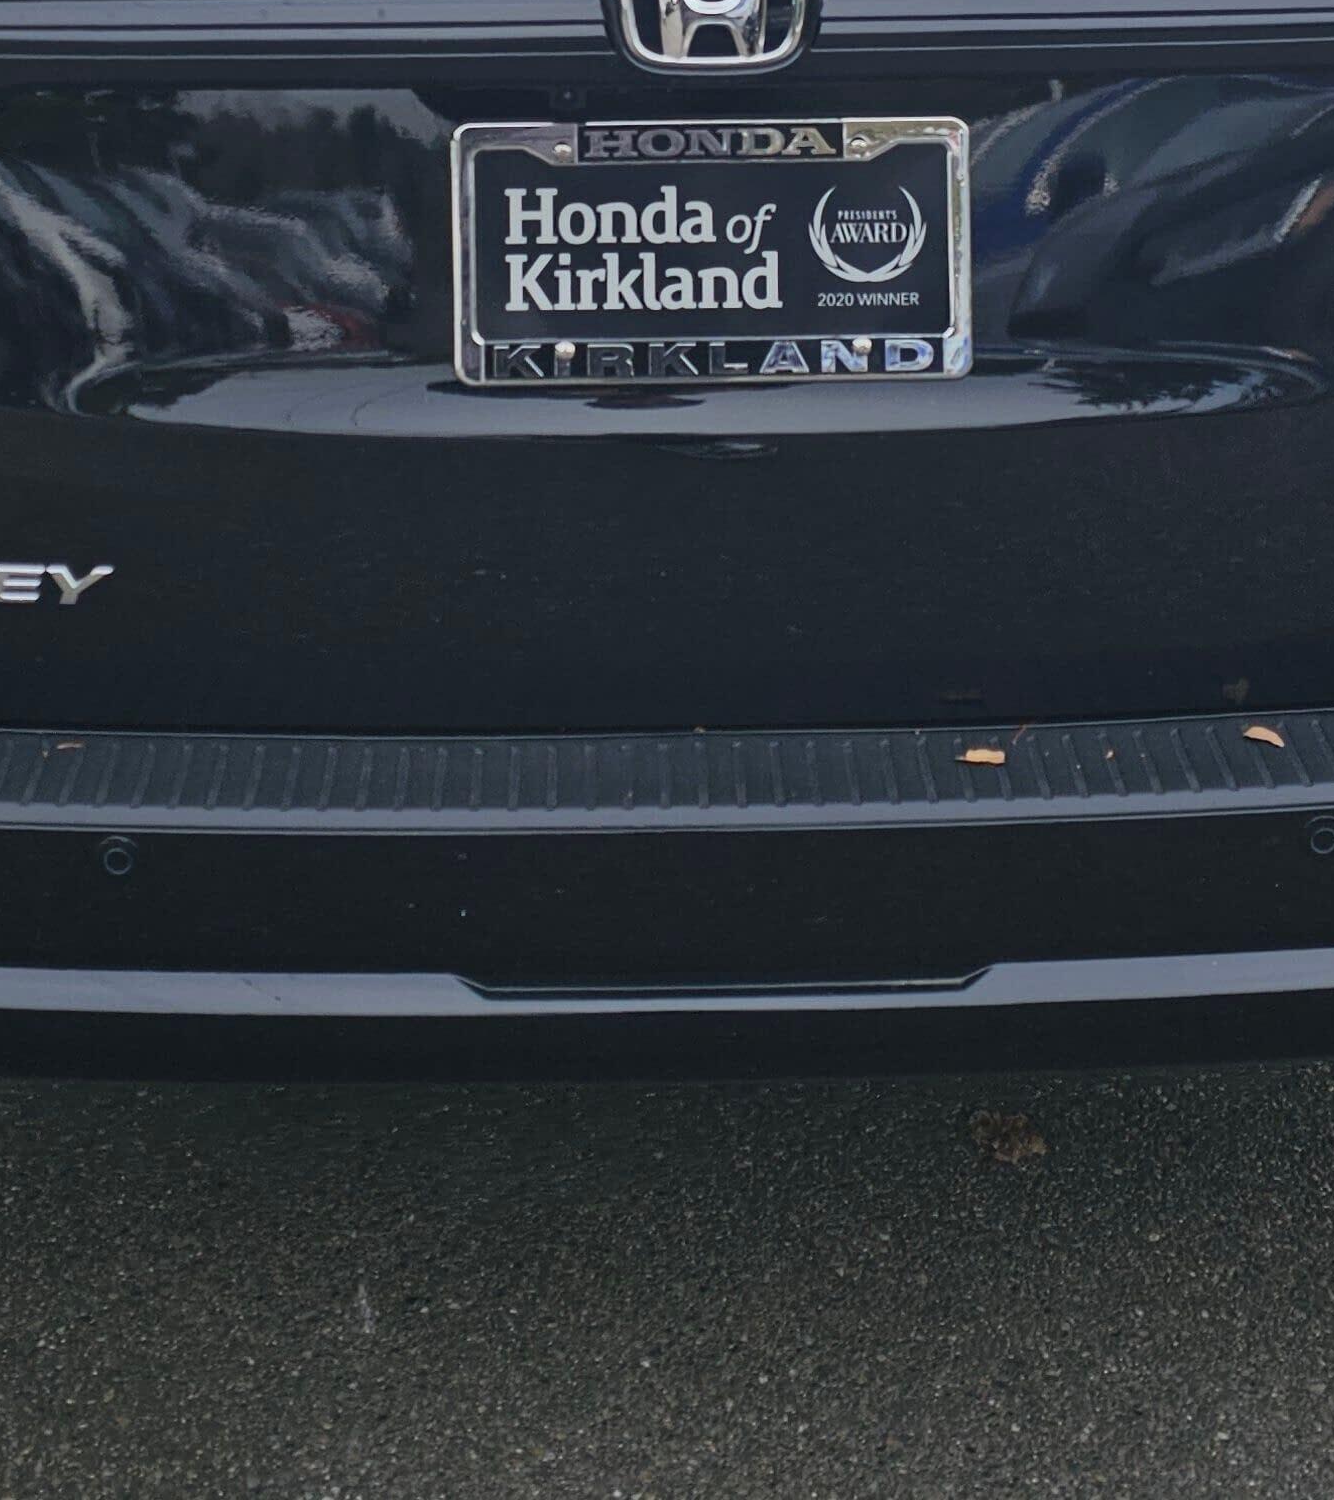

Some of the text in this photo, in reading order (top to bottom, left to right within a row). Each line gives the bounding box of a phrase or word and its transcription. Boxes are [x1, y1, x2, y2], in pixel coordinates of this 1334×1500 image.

[583, 126, 836, 160] HONDA
[504, 185, 777, 254] Honda of
[828, 221, 908, 244] AWARD
[504, 250, 783, 312] Kirkland
[817, 291, 920, 307] 2020 WINNER
[492, 338, 935, 378] KIRKLAND
